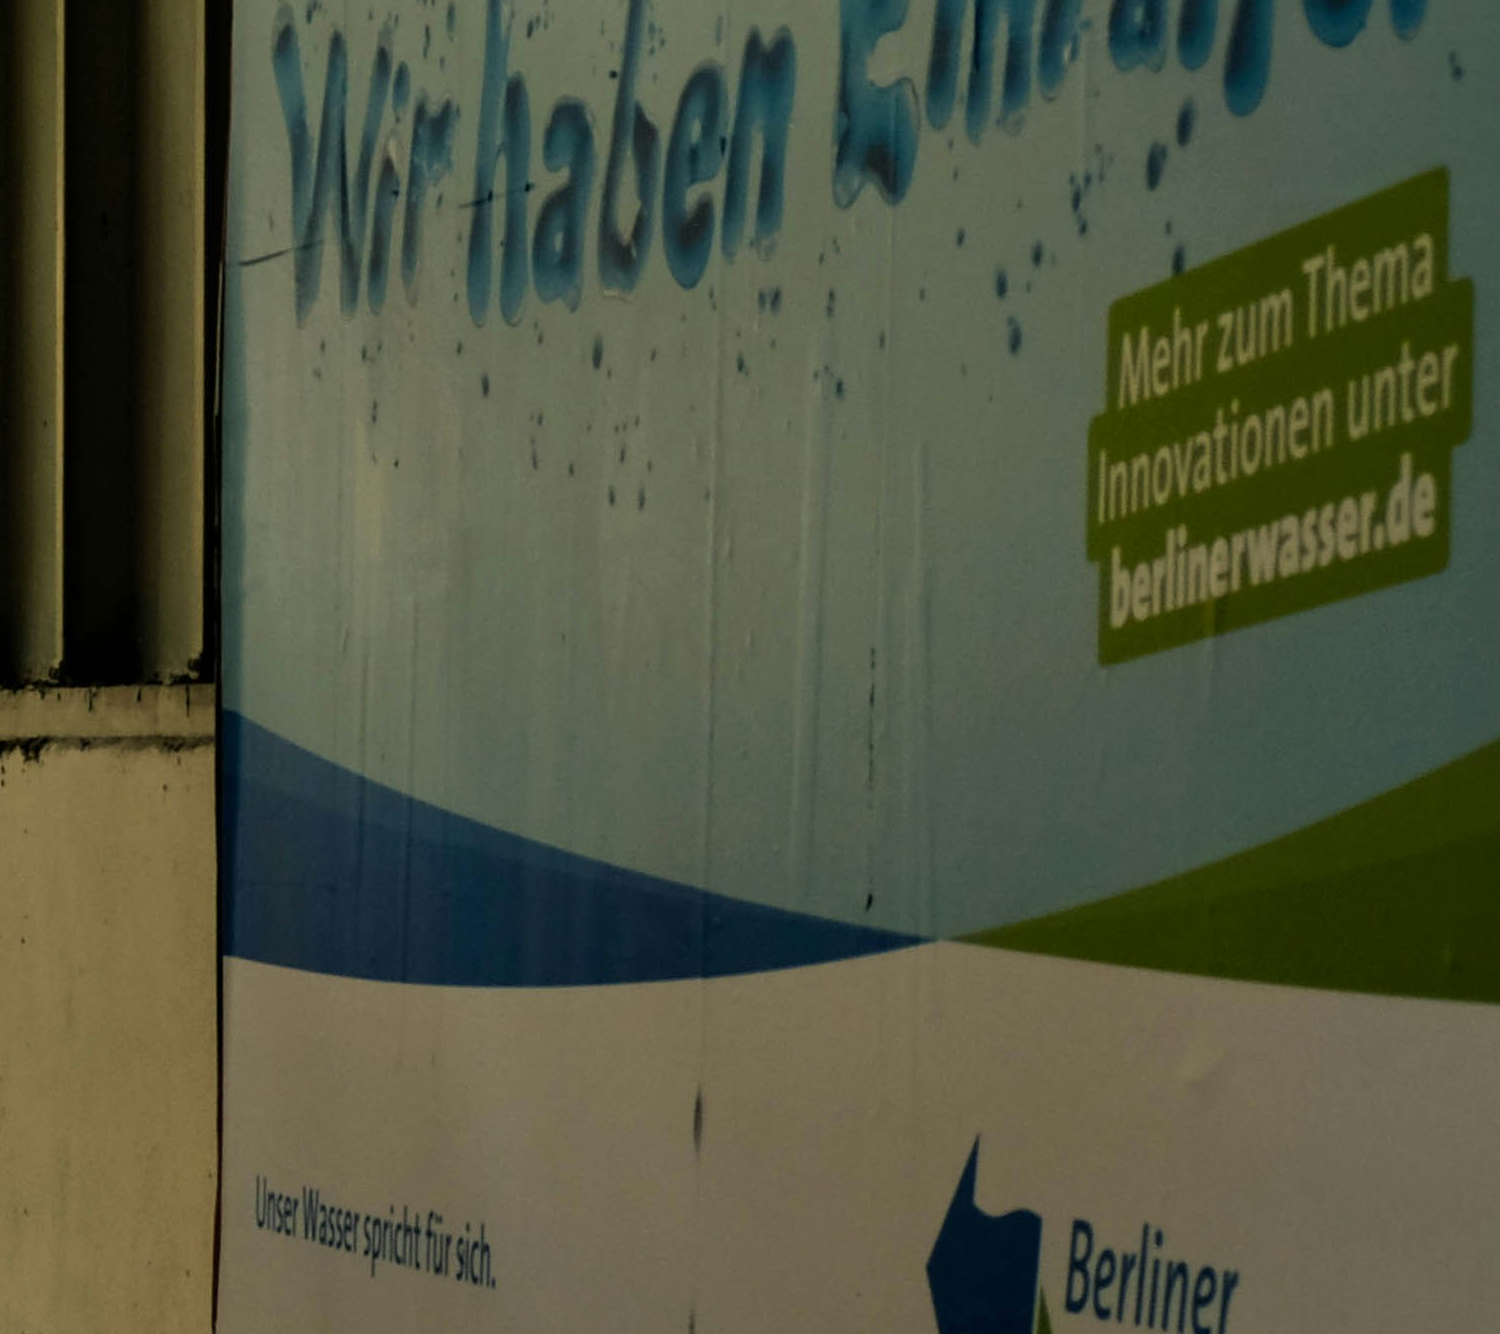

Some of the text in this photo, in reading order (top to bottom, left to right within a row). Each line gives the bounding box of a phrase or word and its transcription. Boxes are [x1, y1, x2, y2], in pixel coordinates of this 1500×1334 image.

[272, 9, 458, 326] Wir
[1118, 233, 1435, 409] Mehr zum Thema
[1098, 342, 1459, 524] Innovationen unter
[1111, 453, 1437, 630] berlinerwasser.de
[256, 1174, 496, 1290] Unser Wasser spricht für sich.
